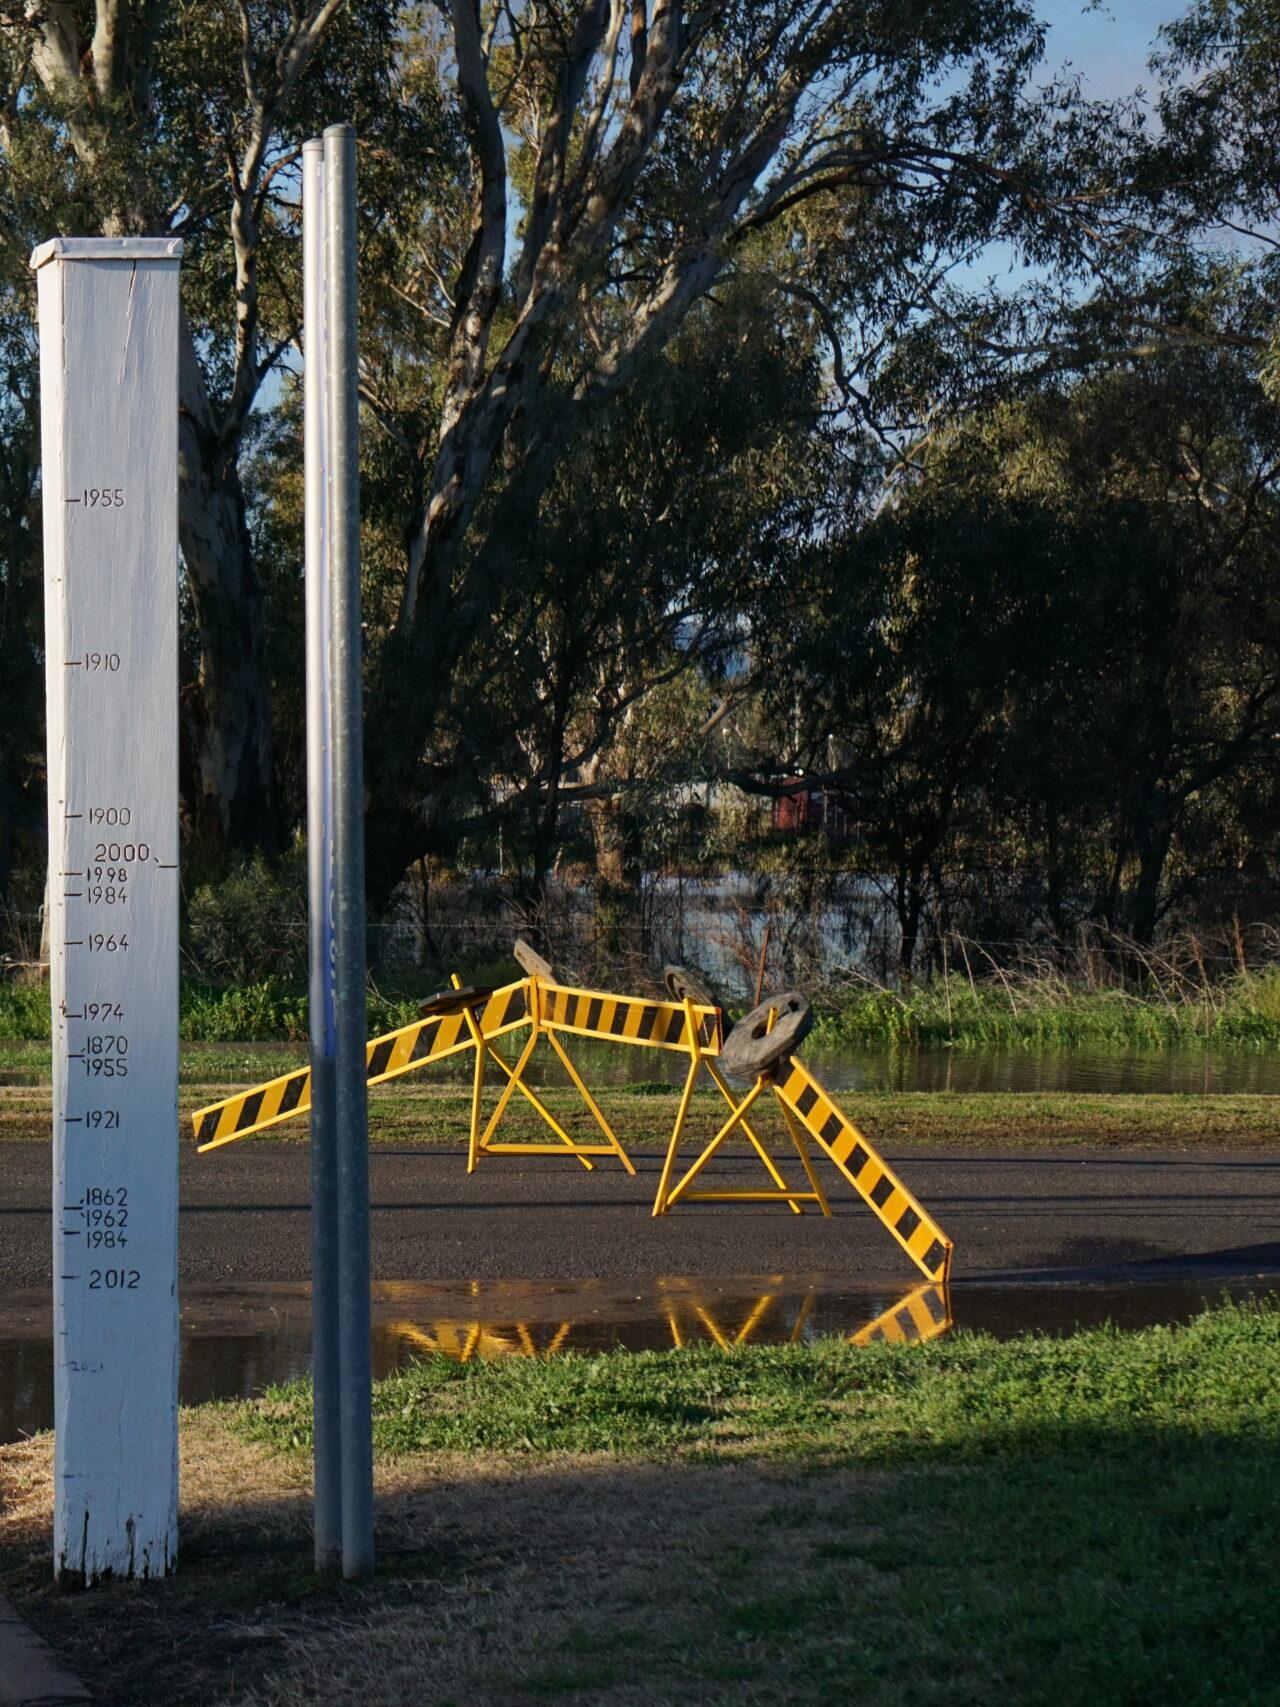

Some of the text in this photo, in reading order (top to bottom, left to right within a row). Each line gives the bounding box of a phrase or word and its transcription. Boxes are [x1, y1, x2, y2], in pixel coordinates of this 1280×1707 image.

[84, 489, 124, 507] 1955
[85, 653, 120, 671] 1910
[89, 807, 131, 826] 1900
[94, 843, 150, 862] 2000
[87, 866, 128, 882] 1998
[87, 886, 128, 904] 1984
[88, 934, 129, 951] 1964
[83, 1003, 125, 1022] 1974
[86, 1035, 128, 1054] 1870
[86, 1058, 128, 1077] 1955
[86, 1110, 120, 1129] 1921
[86, 1187, 128, 1206] 1862
[86, 1209, 128, 1228] 1962
[86, 1230, 128, 1248] 1984
[88, 1269, 140, 1290] 2012
